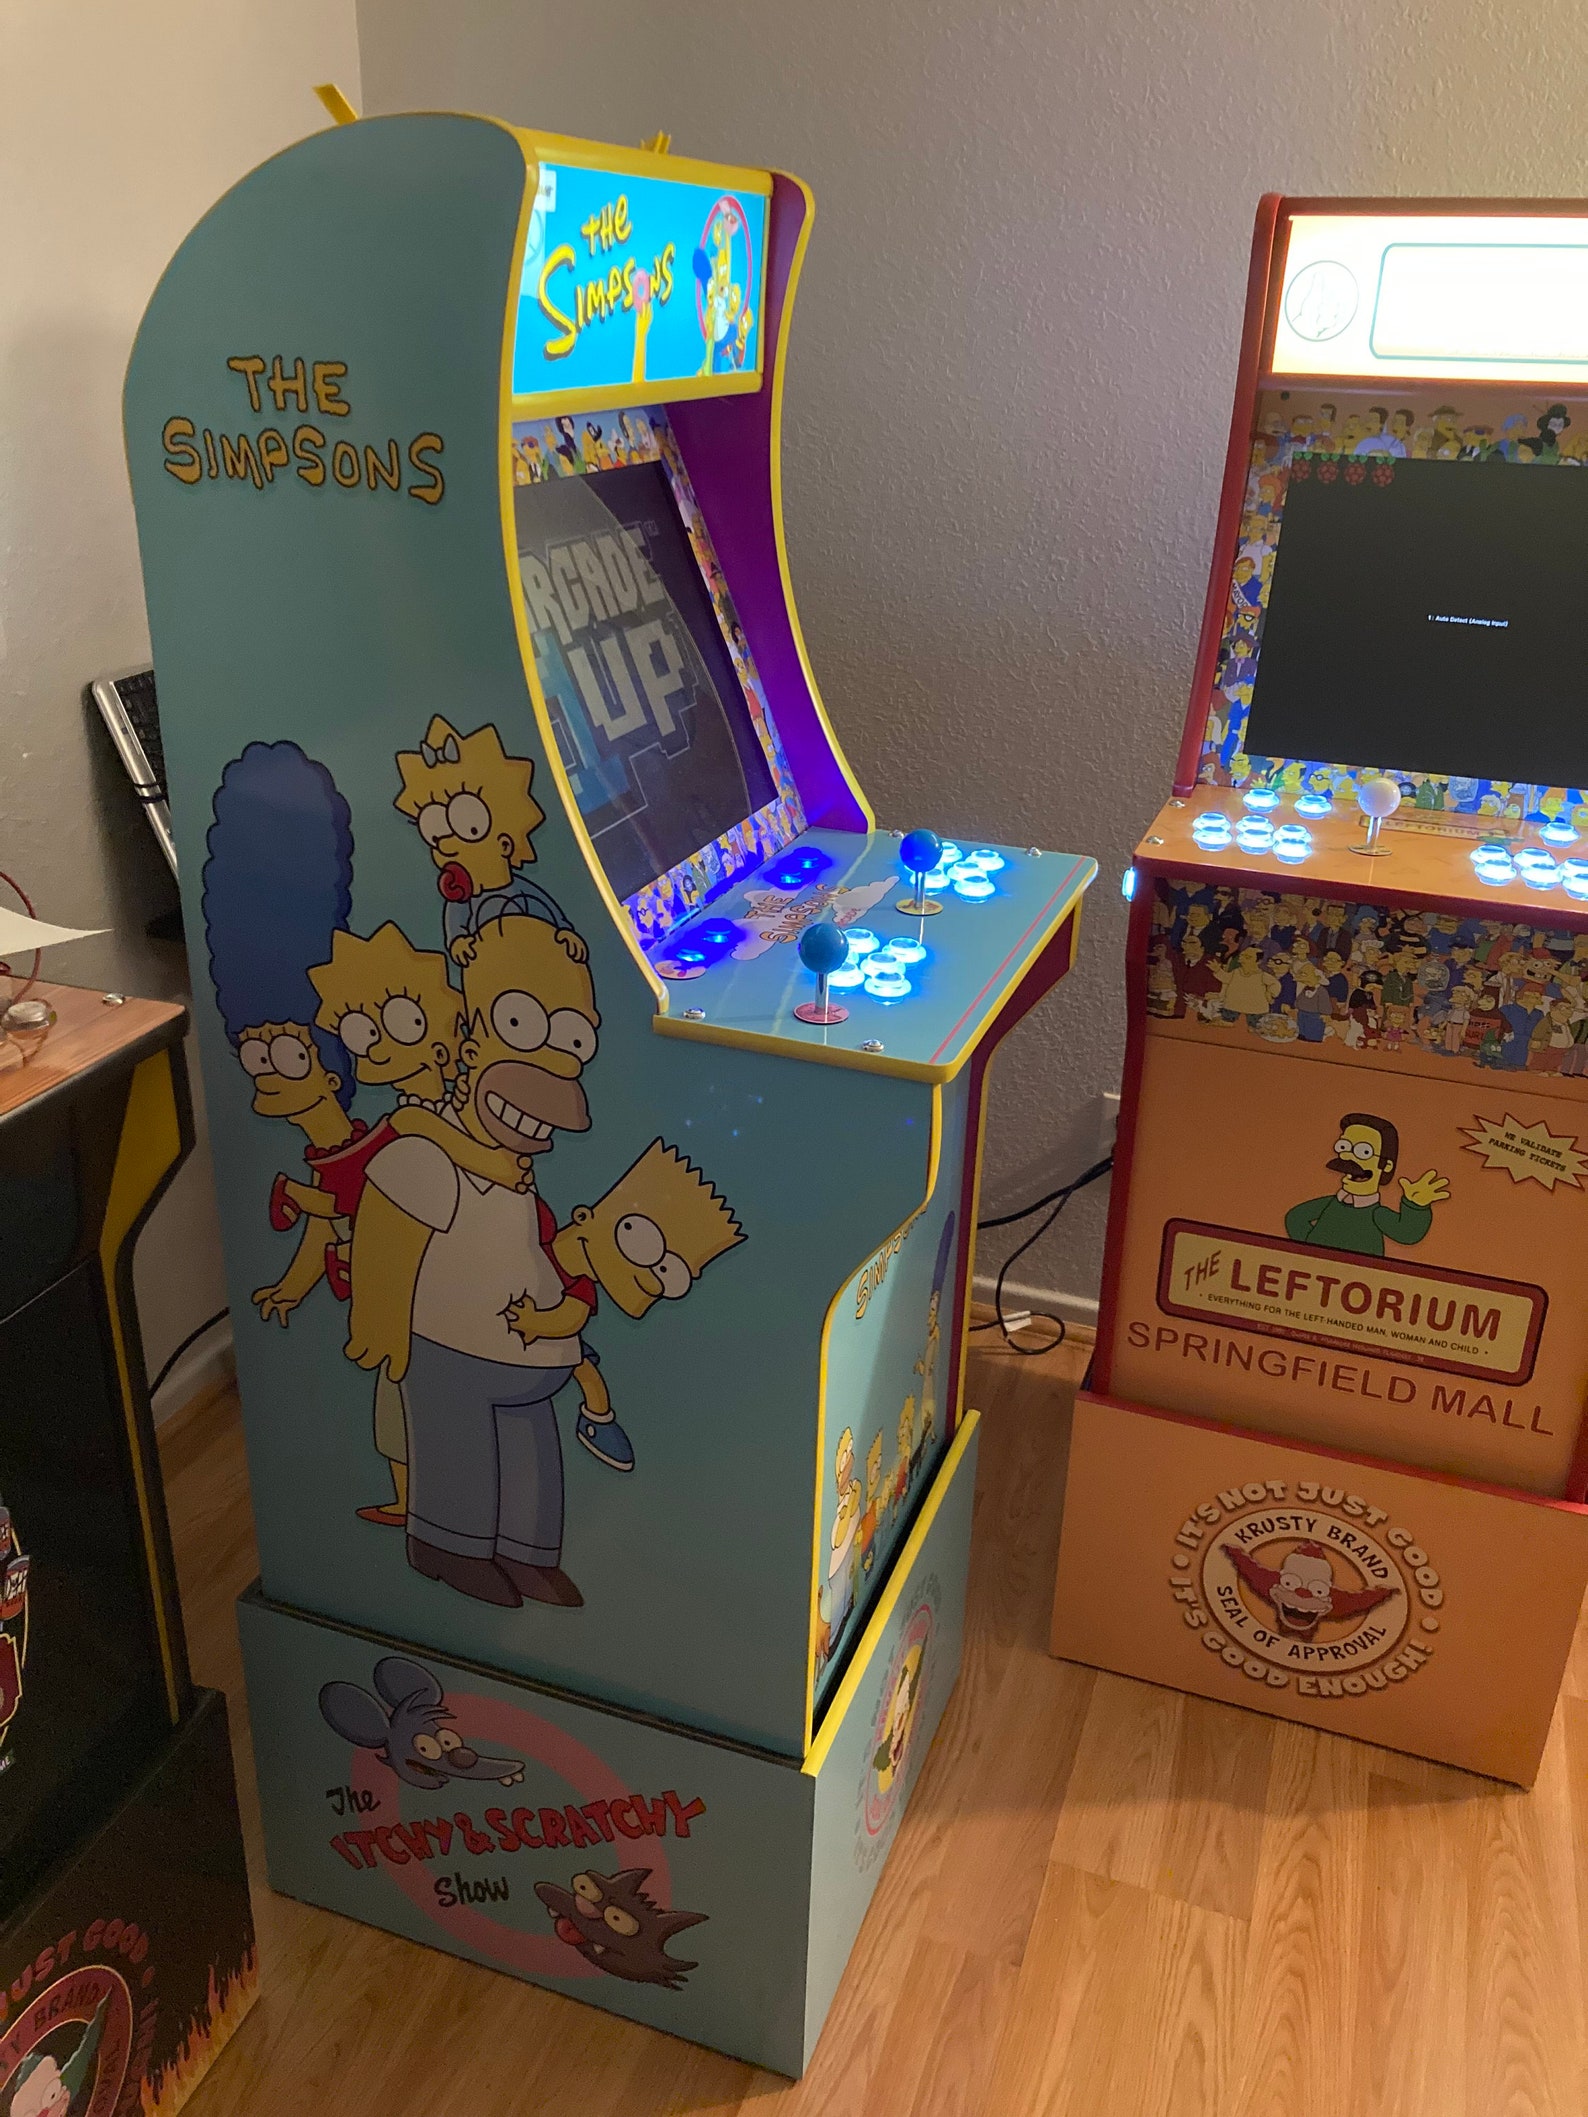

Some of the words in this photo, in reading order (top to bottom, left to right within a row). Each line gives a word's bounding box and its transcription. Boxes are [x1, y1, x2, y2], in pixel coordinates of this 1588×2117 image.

[227, 353, 351, 418] THE
[161, 416, 446, 506] SIMPSONS
[516, 526, 665, 646] RCADE
[1488, 1138, 1526, 1157] PARKING
[1529, 1153, 1567, 1172] TICKETS
[1520, 1137, 1563, 1158] VALIDATE
[1184, 1250, 1222, 1292] THE
[1230, 1258, 1501, 1341] LEFTORIUM
[1207, 1293, 1262, 1312] EVERYTHING
[1263, 1305, 1282, 1316] FOR
[1284, 1309, 1301, 1320] THE
[1366, 1325, 1389, 1338] MAN,
[1391, 1330, 1426, 1344] WOMAN
[1428, 1337, 1449, 1349] AND
[1450, 1342, 1479, 1355] CHILD
[1127, 1321, 1417, 1404] SPRINGFIELD
[1431, 1385, 1554, 1436] MALL
[1176, 1502, 1221, 1549] IT'S
[1217, 1480, 1287, 1511] NOT
[1297, 1481, 1389, 1527] JUST
[1386, 1526, 1444, 1608] GOOD
[1234, 1516, 1318, 1545] KRUSTY
[1327, 1524, 1389, 1580] BRAND
[1170, 1577, 1209, 1629] IT'S
[1202, 1631, 1290, 1688] GOOD
[1298, 1639, 1434, 1697] ENOUGH!
[1216, 1585, 1250, 1629] SEAL
[1253, 1629, 1281, 1649] OF
[1287, 1625, 1388, 1662] APPROVAL
[325, 1785, 381, 1816] The
[485, 1790, 707, 1853] SCRATCHY
[433, 1871, 510, 1908] Show
[82, 1917, 150, 1965] GOOD
